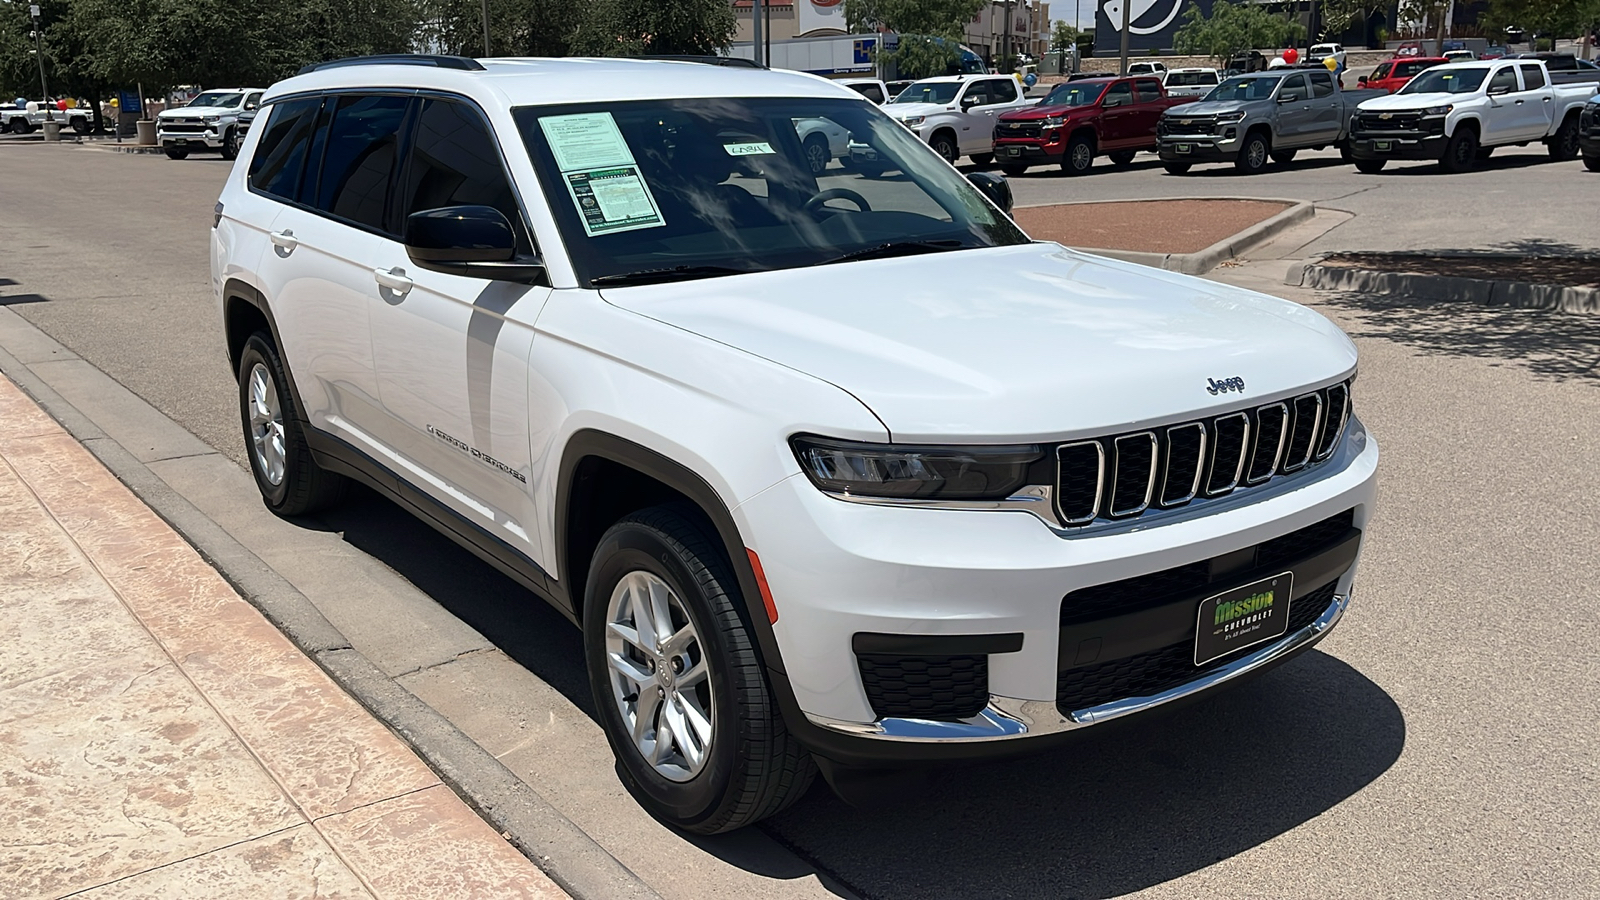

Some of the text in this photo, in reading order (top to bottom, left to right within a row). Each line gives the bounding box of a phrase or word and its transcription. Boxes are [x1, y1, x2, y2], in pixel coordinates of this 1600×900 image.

[1206, 376, 1245, 396] Jeep
[471, 447, 527, 485] CHEROKEE
[1224, 609, 1273, 633] CHEVROLET
